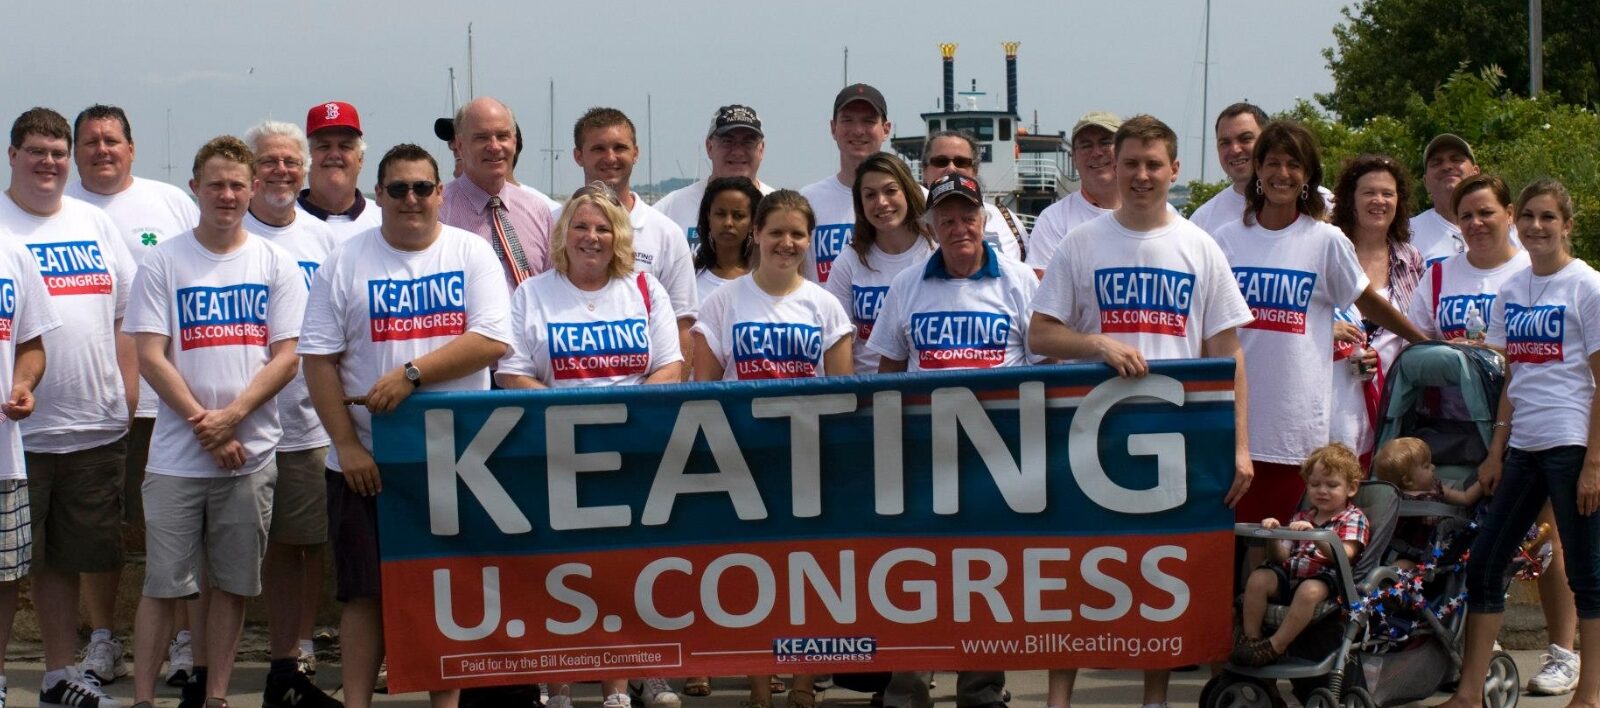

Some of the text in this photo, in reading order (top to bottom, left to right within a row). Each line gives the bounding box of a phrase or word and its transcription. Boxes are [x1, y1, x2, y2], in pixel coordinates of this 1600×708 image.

[325, 103, 340, 120] B
[373, 275, 464, 314] KEATING
[1098, 272, 1192, 310] KEATING
[1233, 271, 1313, 308] EATING
[181, 288, 267, 324] KEATING
[1250, 308, 1305, 326] ONGRESS
[552, 321, 648, 353] KEATING
[735, 325, 822, 360] KEATING
[913, 316, 1008, 346] KEATING
[555, 353, 648, 371] U.S.CONGRESS
[424, 374, 1188, 537] KEATING
[776, 637, 873, 654] KEATING
[777, 654, 801, 663] U.S.
[804, 653, 872, 662] CONGRESS
[961, 632, 1183, 657] www.BillKeating.org
[461, 651, 662, 672] Paid for by the Bill Keating Committee
